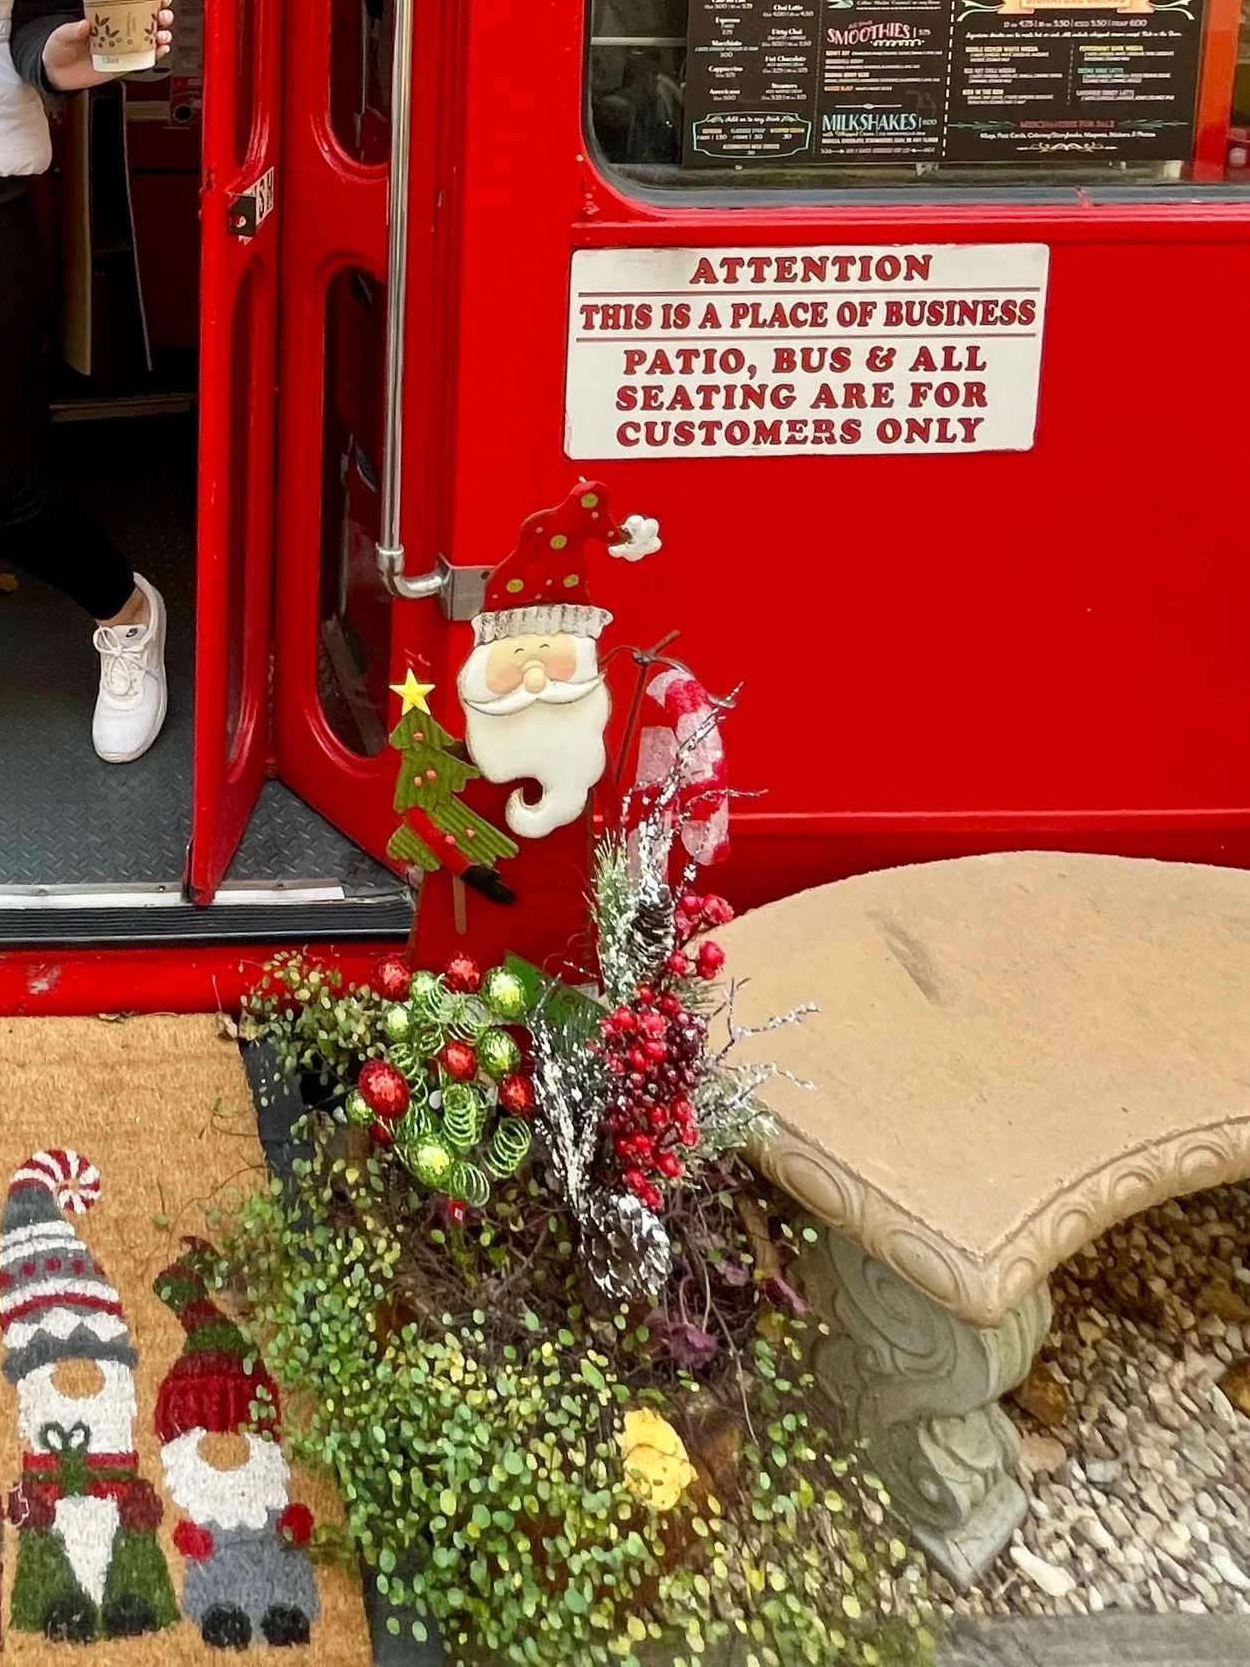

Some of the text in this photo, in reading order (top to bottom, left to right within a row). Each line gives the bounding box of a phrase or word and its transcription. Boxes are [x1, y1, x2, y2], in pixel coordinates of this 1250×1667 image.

[827, 23, 911, 45] SMOOTHIES
[822, 114, 918, 131] MILKSHAKES
[689, 254, 933, 285] ATTENTION
[580, 299, 1036, 330] THIS IS A PLACE OF BUSINESS
[623, 345, 987, 380] PATIO, BUS & ALL
[615, 381, 989, 411] SEATING ARE FOR
[616, 417, 986, 447] CUSTOMERS ONLY
